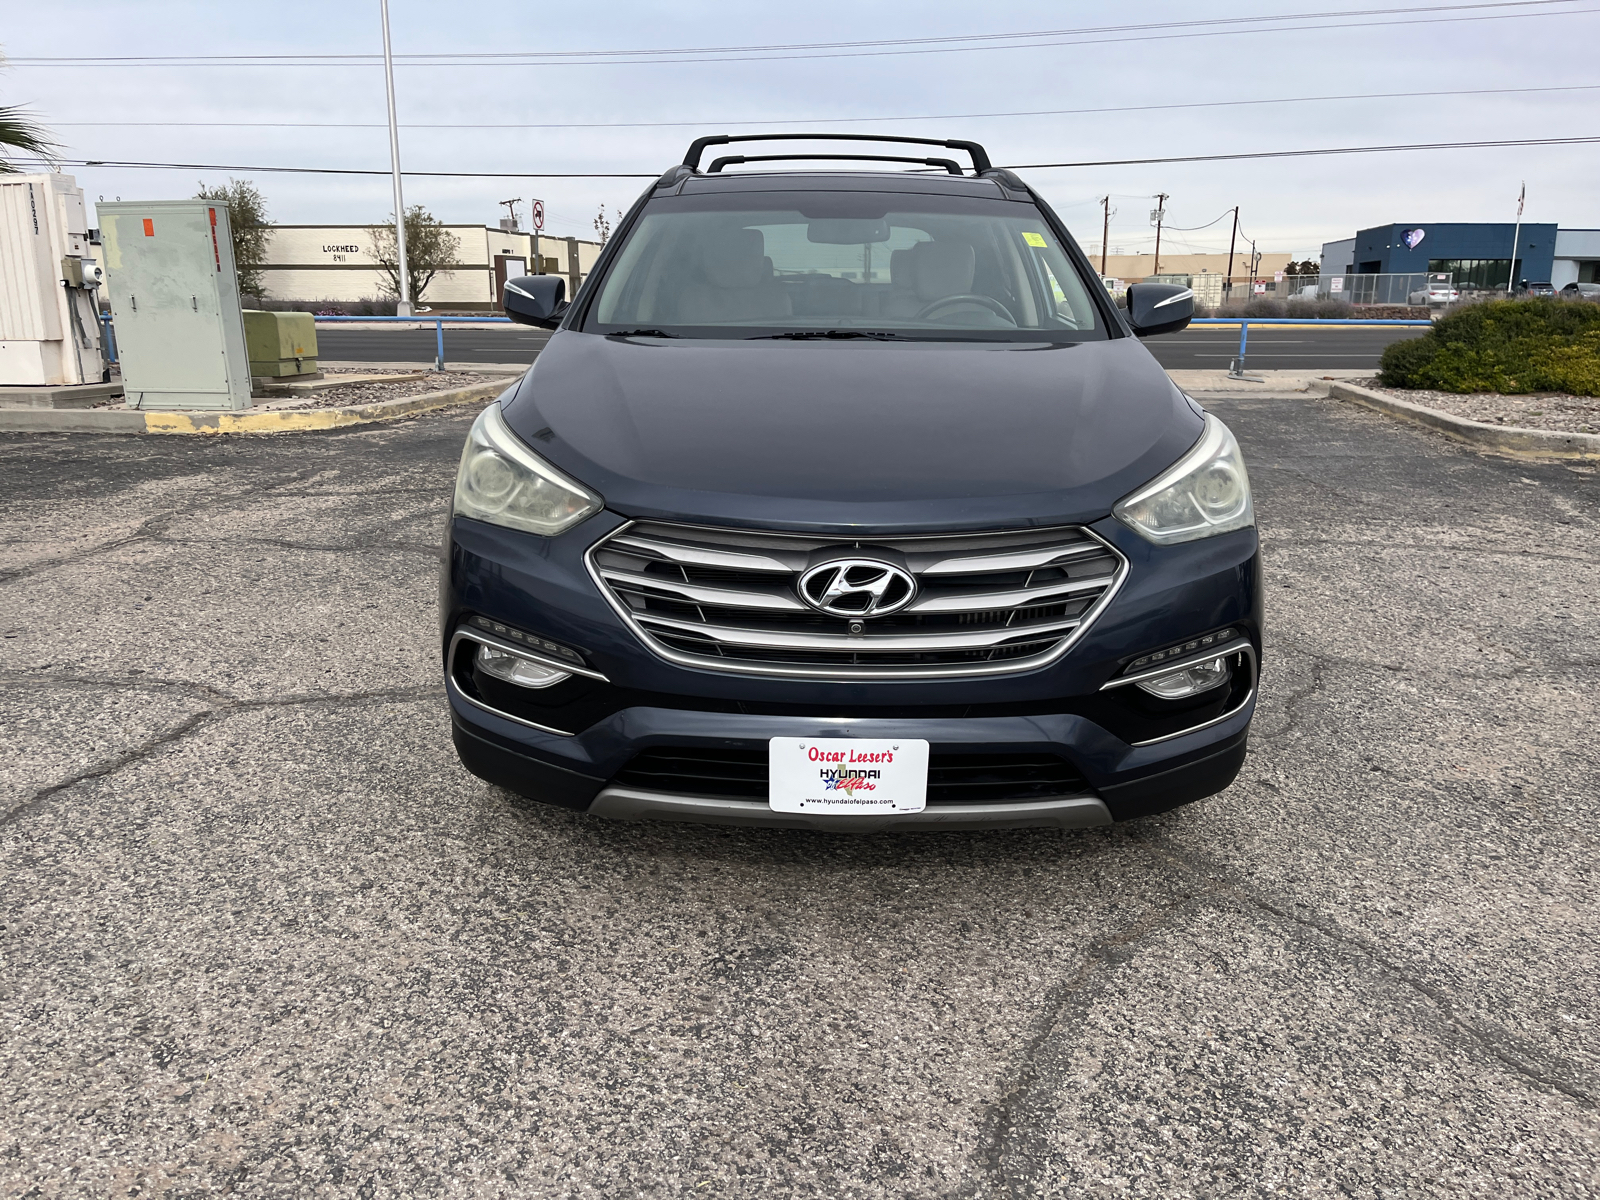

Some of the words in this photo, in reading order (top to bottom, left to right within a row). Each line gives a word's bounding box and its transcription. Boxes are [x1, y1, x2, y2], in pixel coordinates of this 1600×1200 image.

[322, 245, 359, 253] LOCKHEED
[808, 746, 846, 763] Oscar
[848, 749, 893, 763] Leeser's
[820, 769, 880, 779] HYUNDAI
